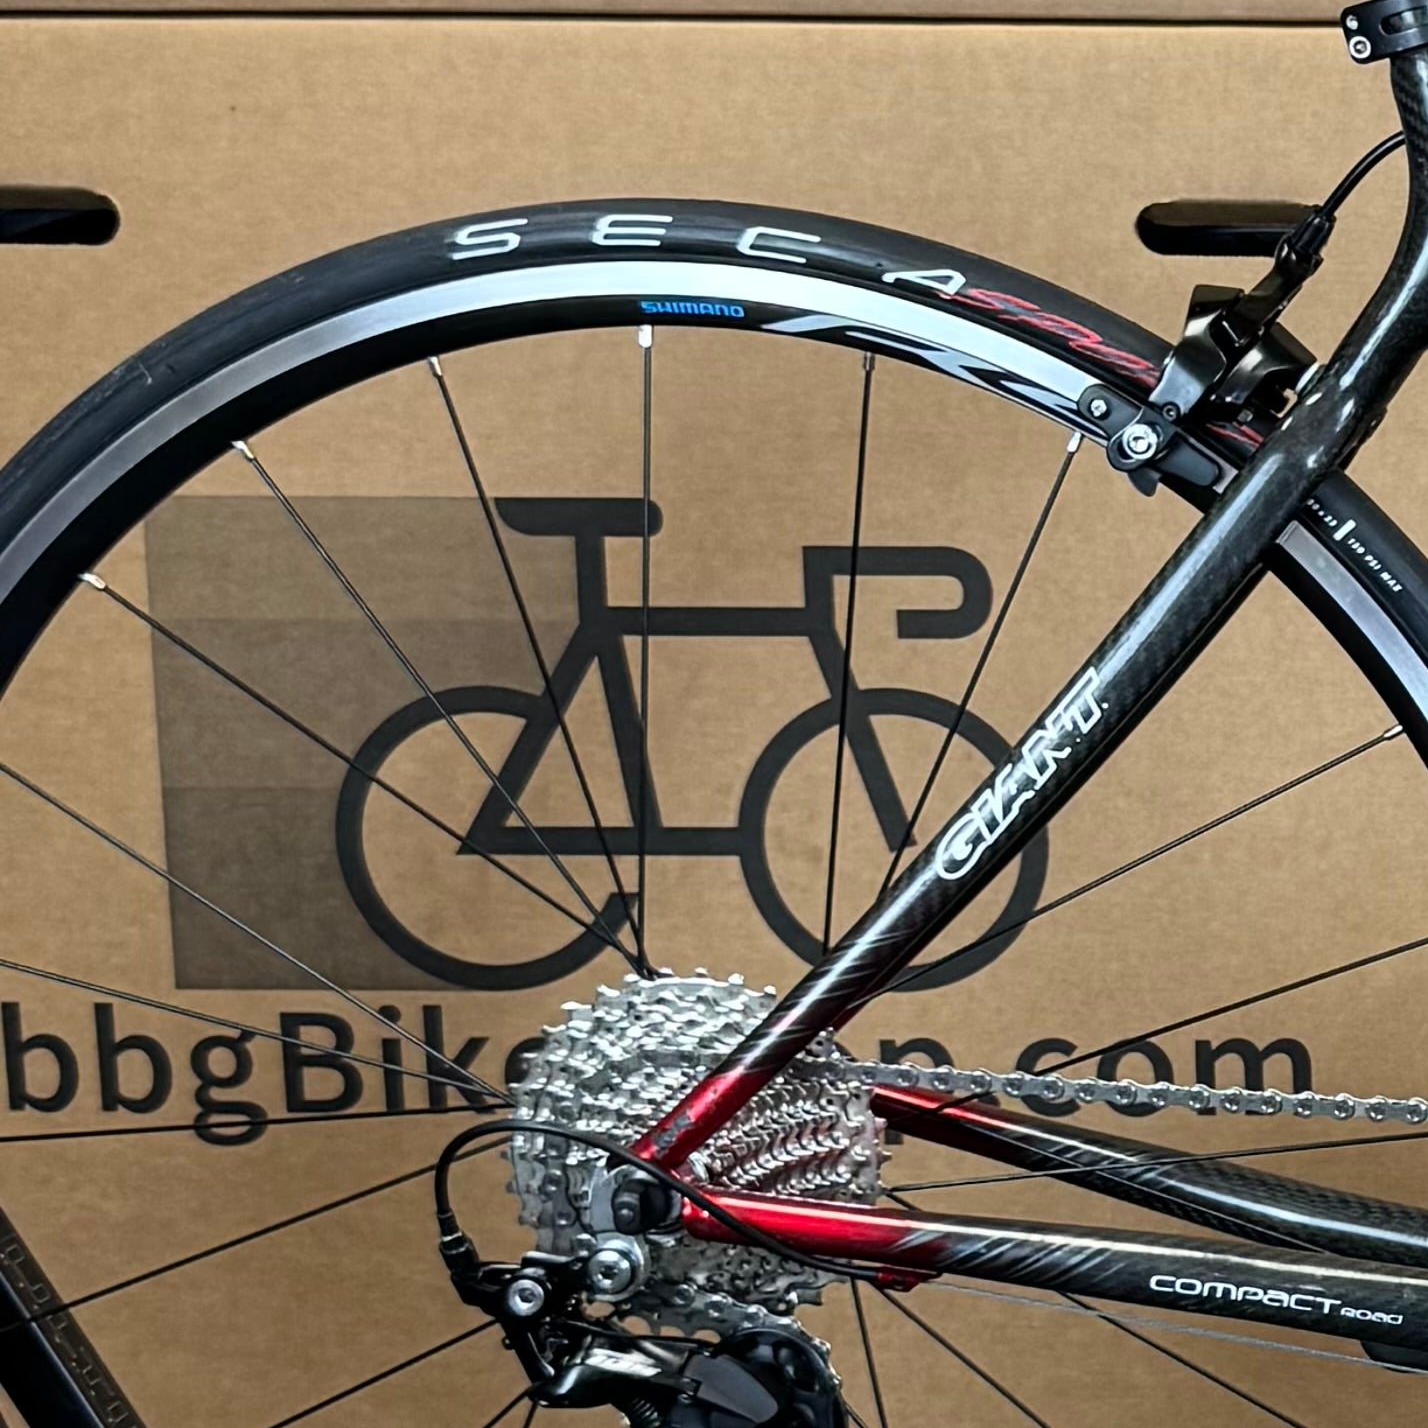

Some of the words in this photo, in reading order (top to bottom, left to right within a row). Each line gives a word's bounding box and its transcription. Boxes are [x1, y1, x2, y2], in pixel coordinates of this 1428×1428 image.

[452, 214, 967, 296] SECA
[640, 301, 745, 318] SHIMANO
[936, 666, 1102, 880] GIANT
[1150, 1274, 1342, 1314] COMPACT
[1340, 1307, 1403, 1325] ROAD
